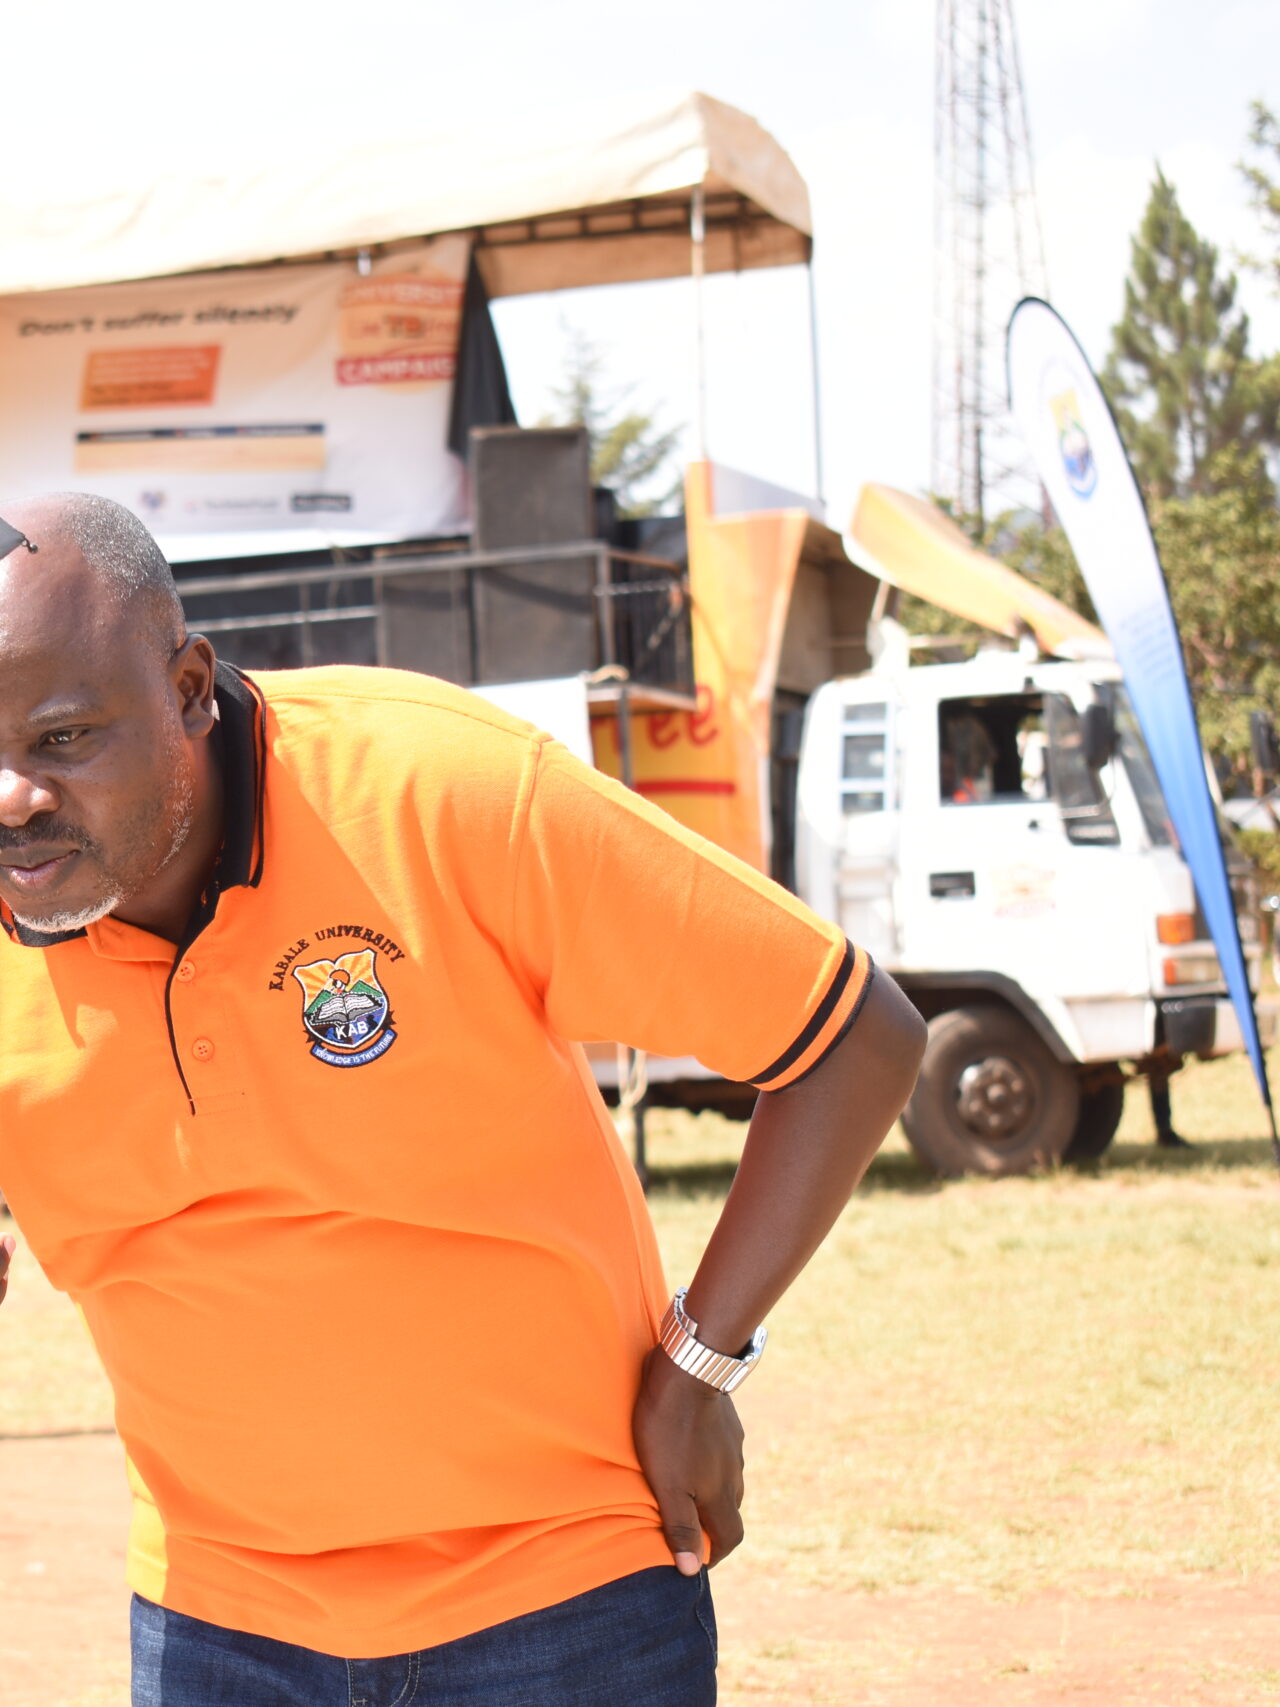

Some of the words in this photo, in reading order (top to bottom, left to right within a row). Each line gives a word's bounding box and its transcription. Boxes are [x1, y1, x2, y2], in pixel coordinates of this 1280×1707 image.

[19, 315, 95, 336] Don't
[104, 310, 186, 331] suffer
[194, 303, 300, 325] silently
[340, 357, 457, 382] CAMPAIG
[268, 938, 310, 992] KABALE
[314, 924, 406, 963] UNIVERSITY
[334, 1020, 370, 1040] KAB
[353, 1056, 361, 1064] IS
[361, 1050, 375, 1062] THE
[374, 1033, 394, 1054] FUTURE
